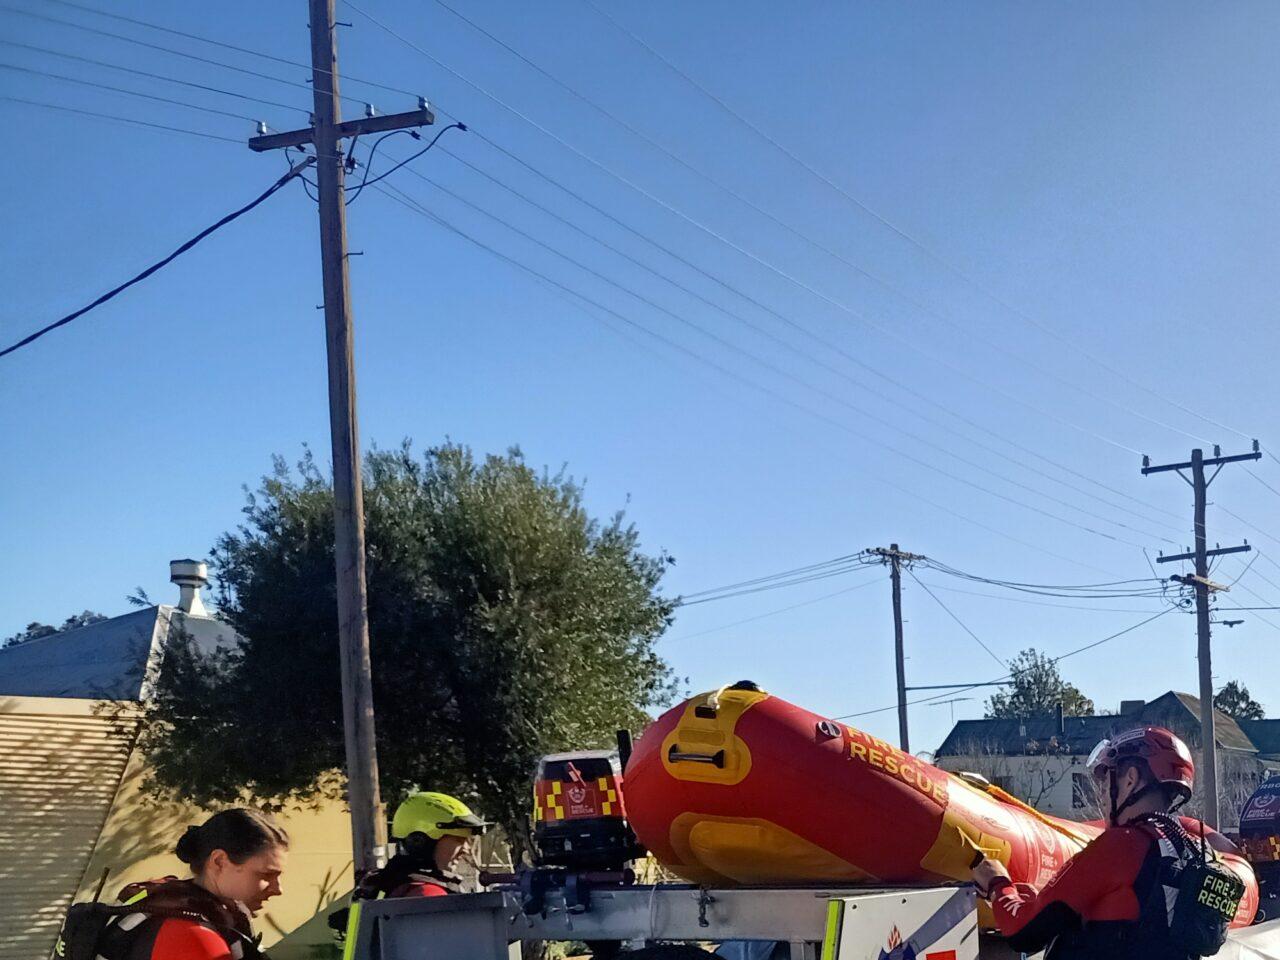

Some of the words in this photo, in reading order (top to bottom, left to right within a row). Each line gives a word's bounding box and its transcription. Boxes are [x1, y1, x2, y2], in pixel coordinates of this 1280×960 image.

[850, 742, 949, 805] RESCUE
[1203, 875, 1230, 896] FIRE
[1198, 890, 1237, 917] RESCUE
